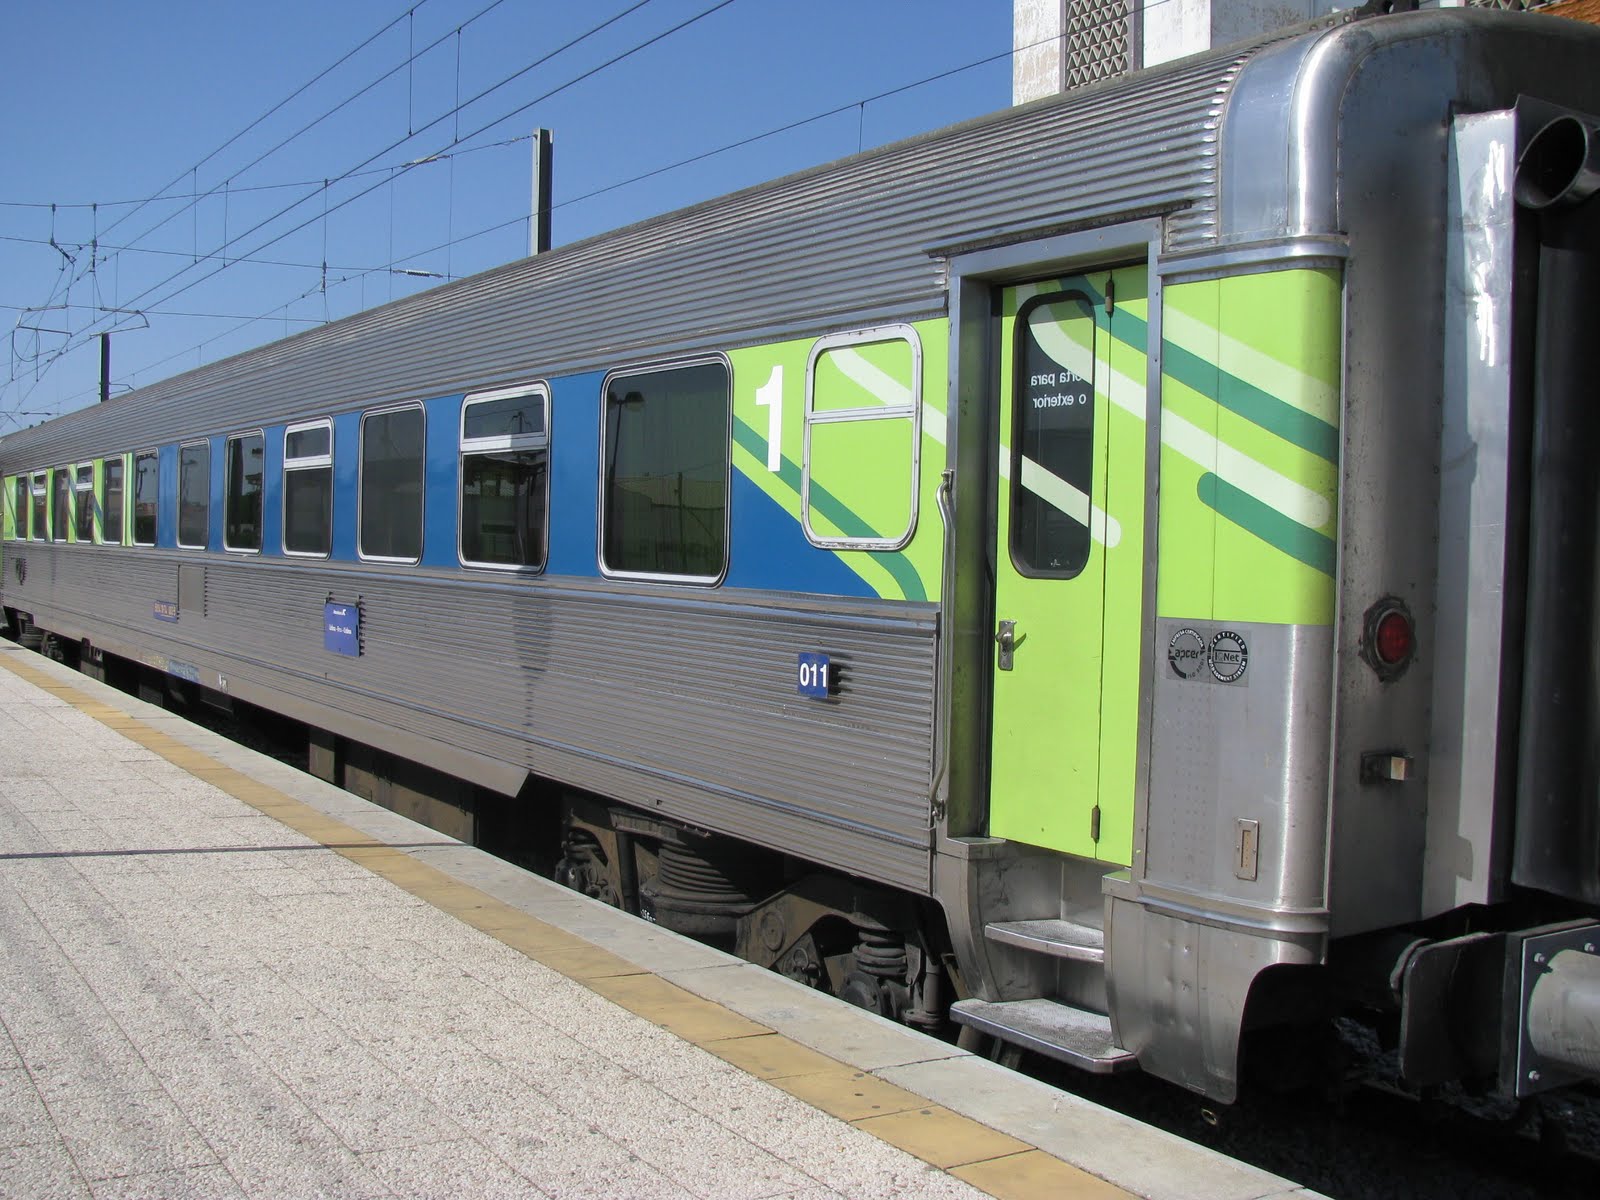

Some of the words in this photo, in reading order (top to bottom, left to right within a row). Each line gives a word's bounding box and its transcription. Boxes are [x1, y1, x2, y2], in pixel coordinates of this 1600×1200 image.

[755, 365, 784, 472] 1
[1174, 648, 1200, 661] apcer
[800, 662, 828, 688] 011
